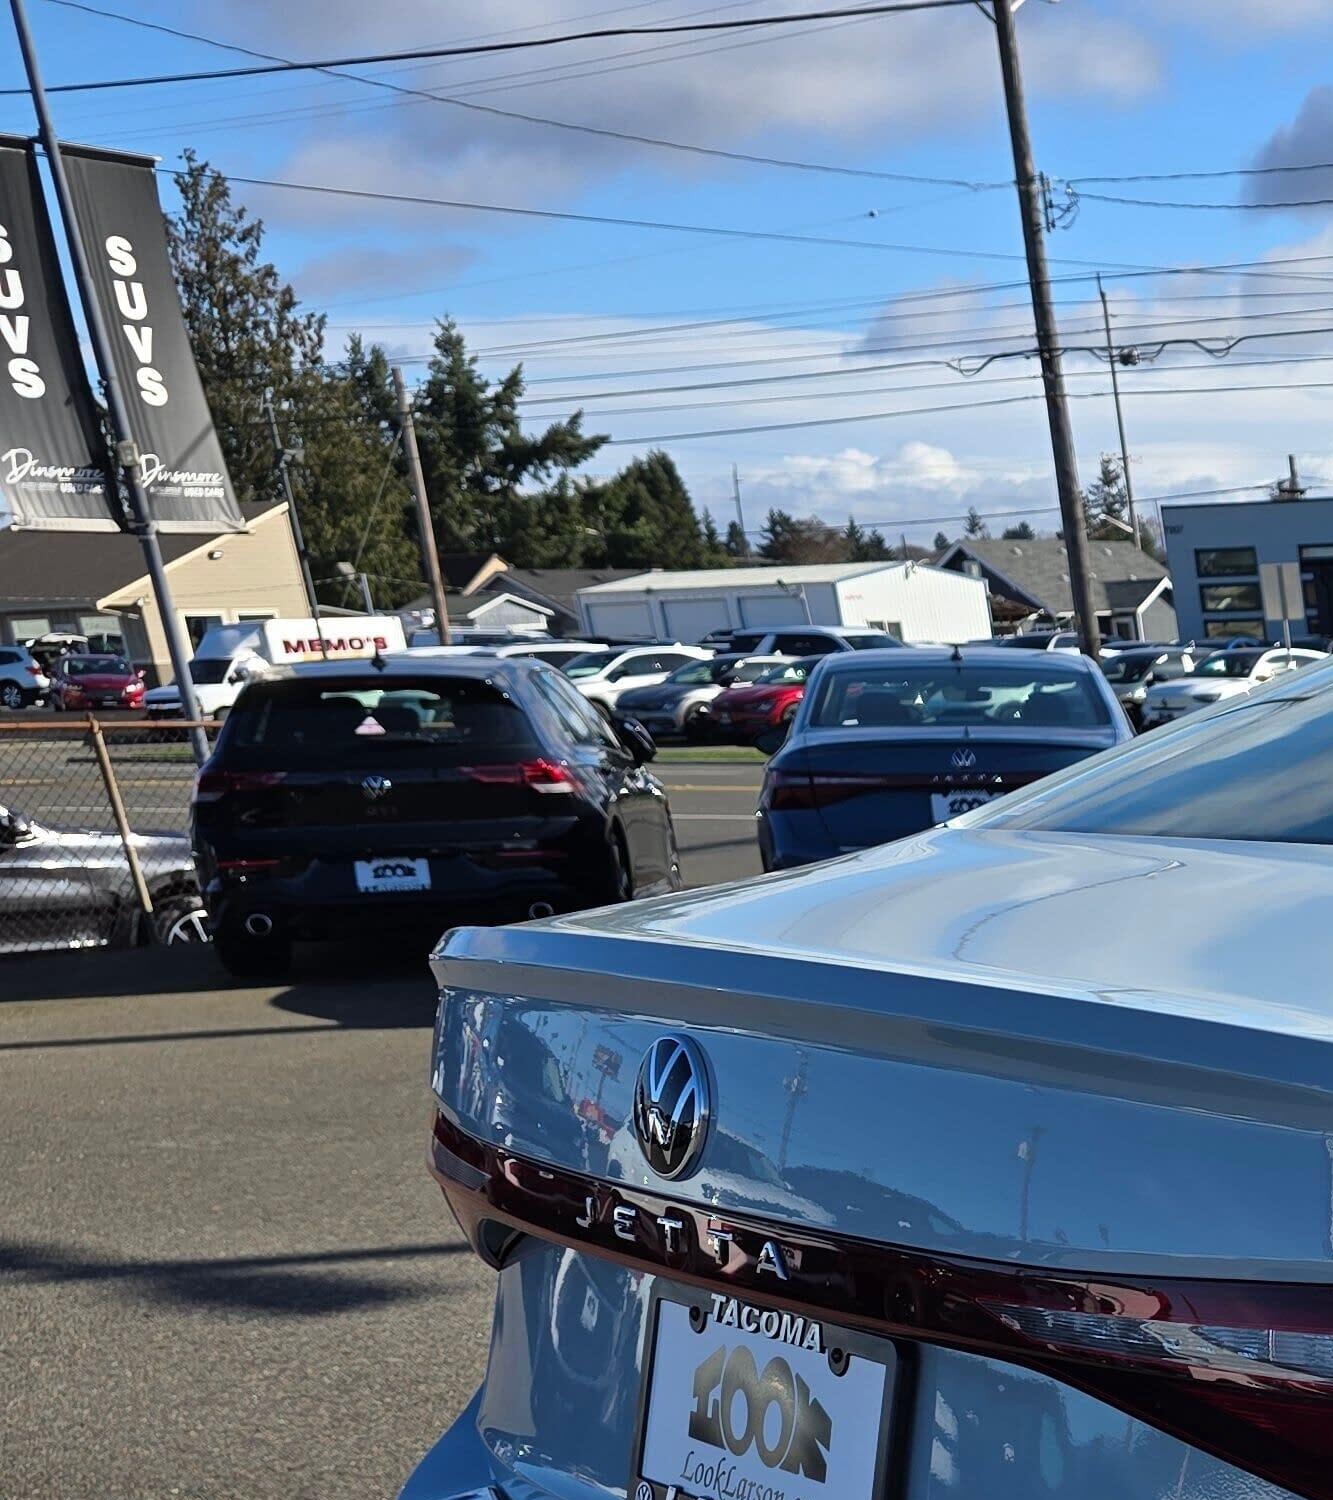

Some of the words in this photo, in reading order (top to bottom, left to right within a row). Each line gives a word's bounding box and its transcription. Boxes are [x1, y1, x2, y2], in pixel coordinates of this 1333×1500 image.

[105, 235, 169, 406] SUVS
[139, 453, 224, 489] Dinsmore
[576, 1195, 791, 1281] JETTA
[710, 1293, 826, 1354] TACOMA
